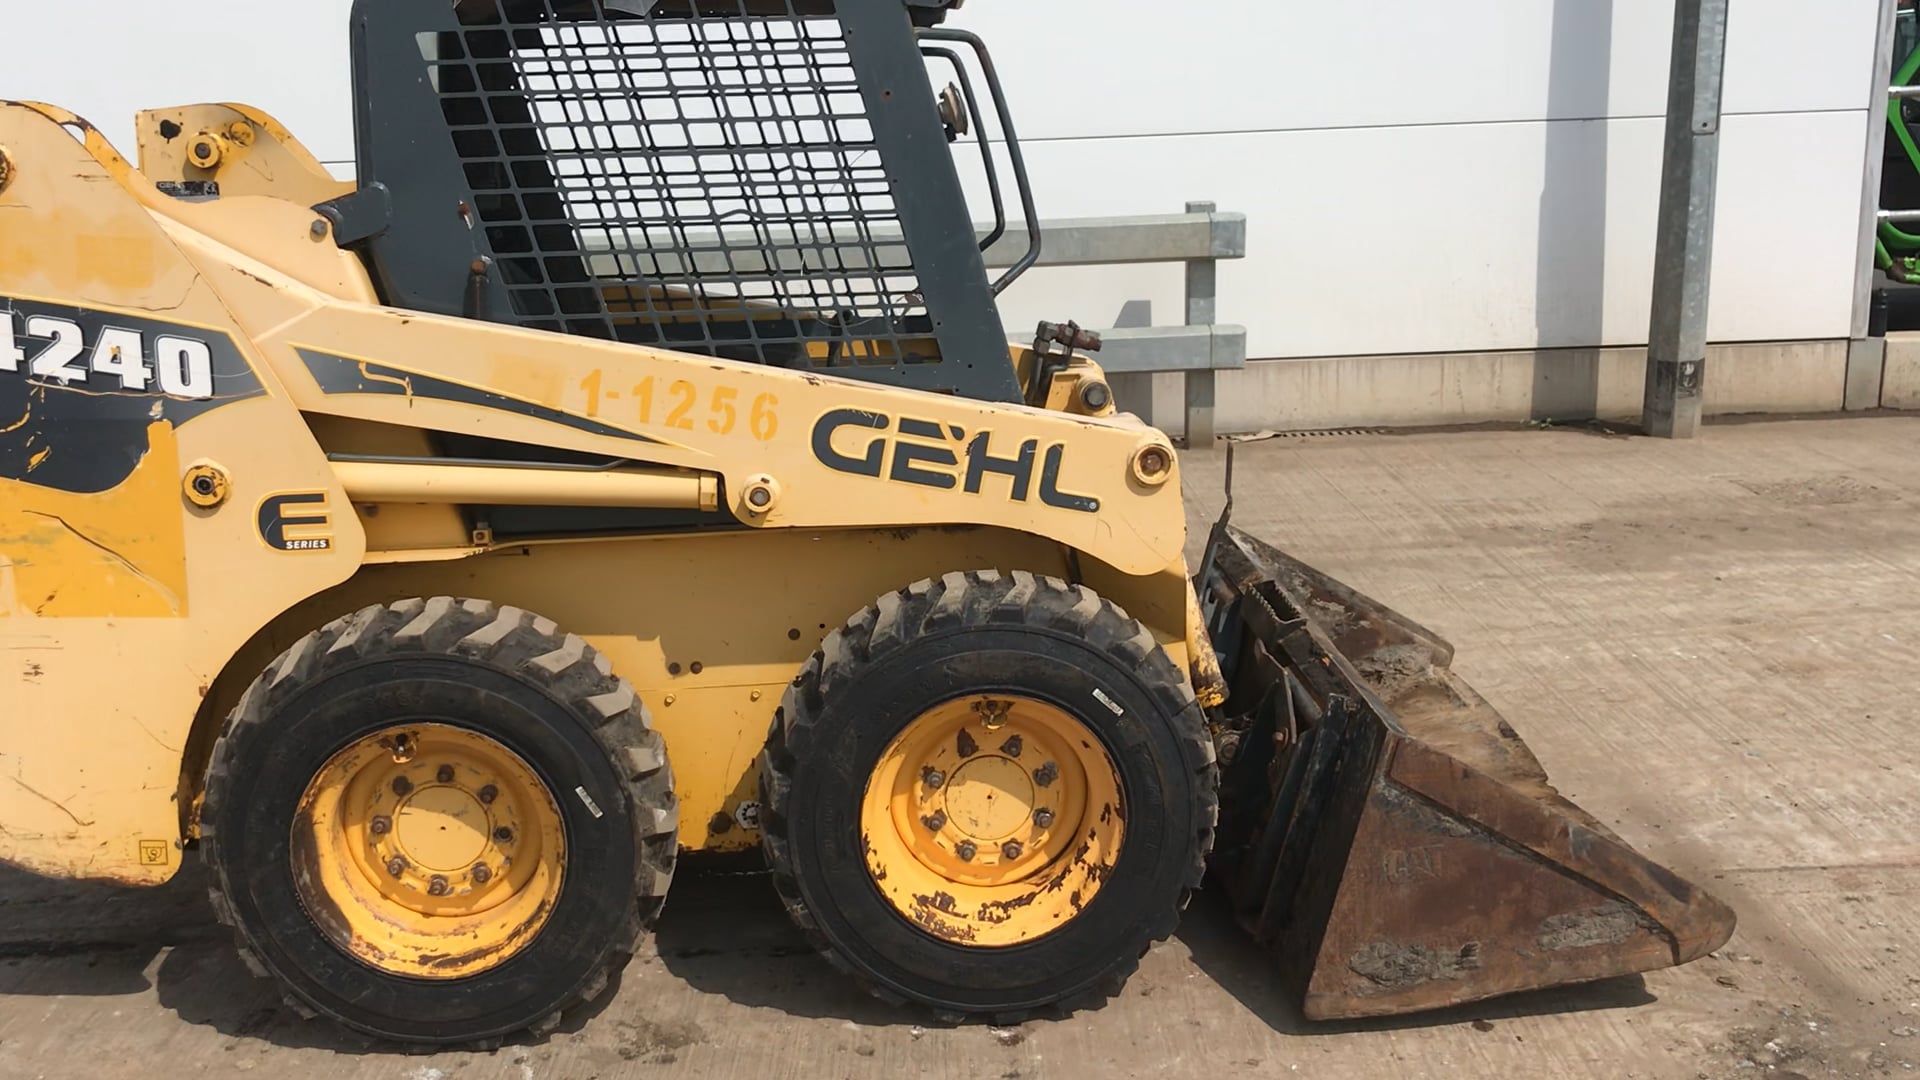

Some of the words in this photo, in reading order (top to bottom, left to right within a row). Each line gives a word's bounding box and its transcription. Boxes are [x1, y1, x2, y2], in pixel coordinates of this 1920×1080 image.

[579, 368, 779, 441] 1-1256
[811, 408, 1098, 513] GEHL
[258, 493, 330, 550] E
[286, 540, 327, 549] SERIES
